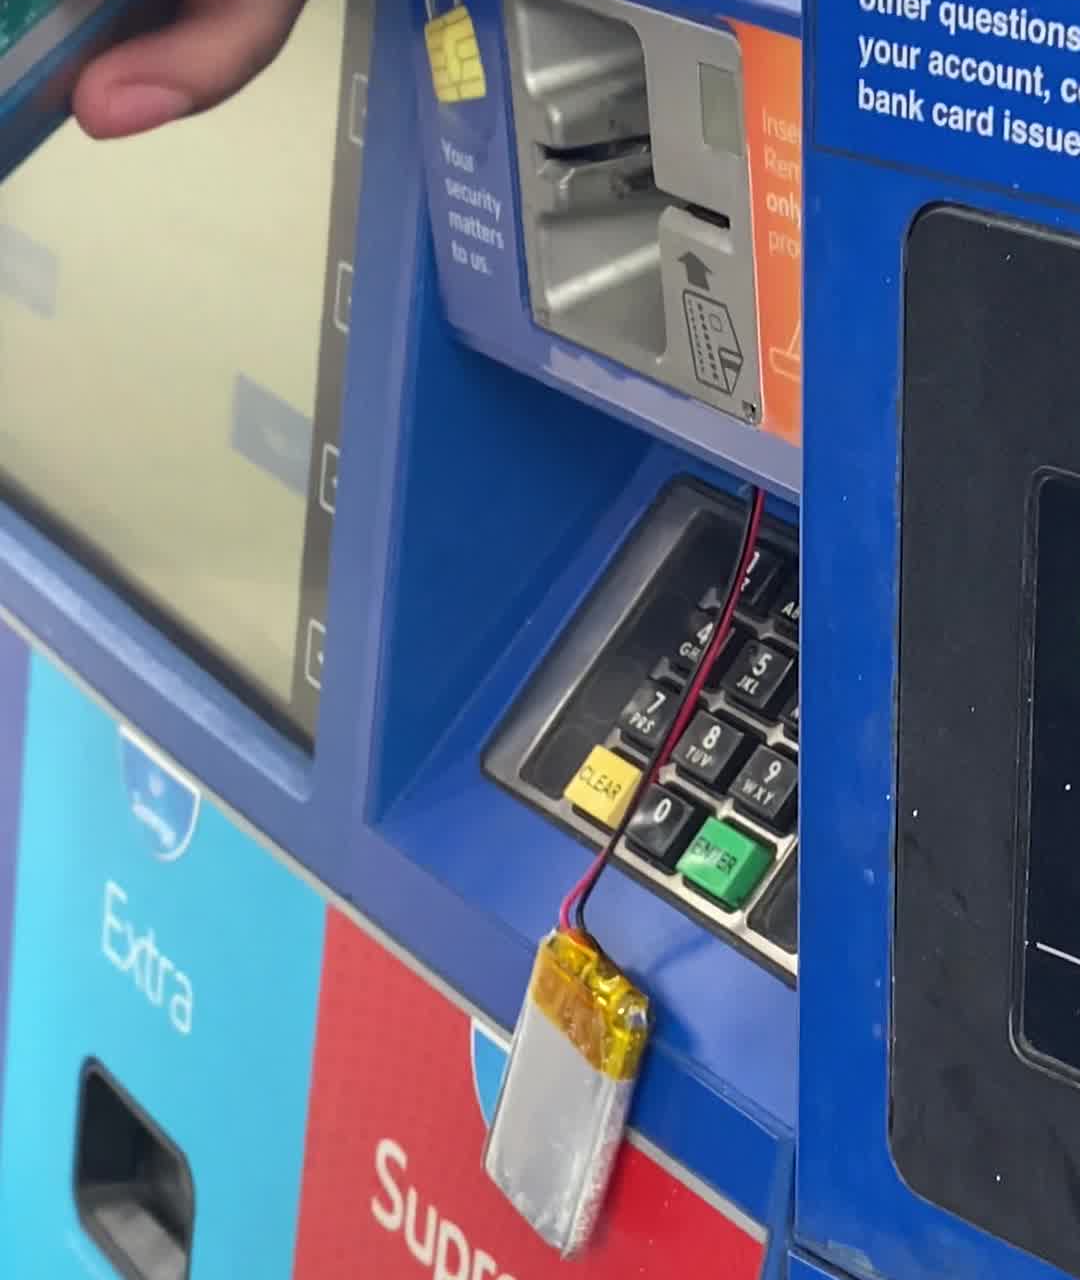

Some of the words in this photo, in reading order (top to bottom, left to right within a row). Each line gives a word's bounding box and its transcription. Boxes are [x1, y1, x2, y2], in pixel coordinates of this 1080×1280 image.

[858, 35, 921, 70] your
[928, 47, 1051, 103] account,
[858, 79, 925, 121] bank
[932, 99, 994, 138] card
[445, 177, 501, 222] security
[448, 210, 505, 250] matters
[451, 240, 468, 264] to
[752, 653, 773, 677] 5
[736, 675, 760, 696] JKL
[647, 691, 667, 714] 7
[702, 725, 721, 750] 8
[685, 745, 713, 768] TUV
[578, 766, 623, 799] CLEAR
[763, 760, 782, 783] 9
[742, 780, 775, 806] WXY
[653, 798, 673, 823] 0
[691, 837, 738, 873] ENTER
[102, 881, 193, 1034] Extra
